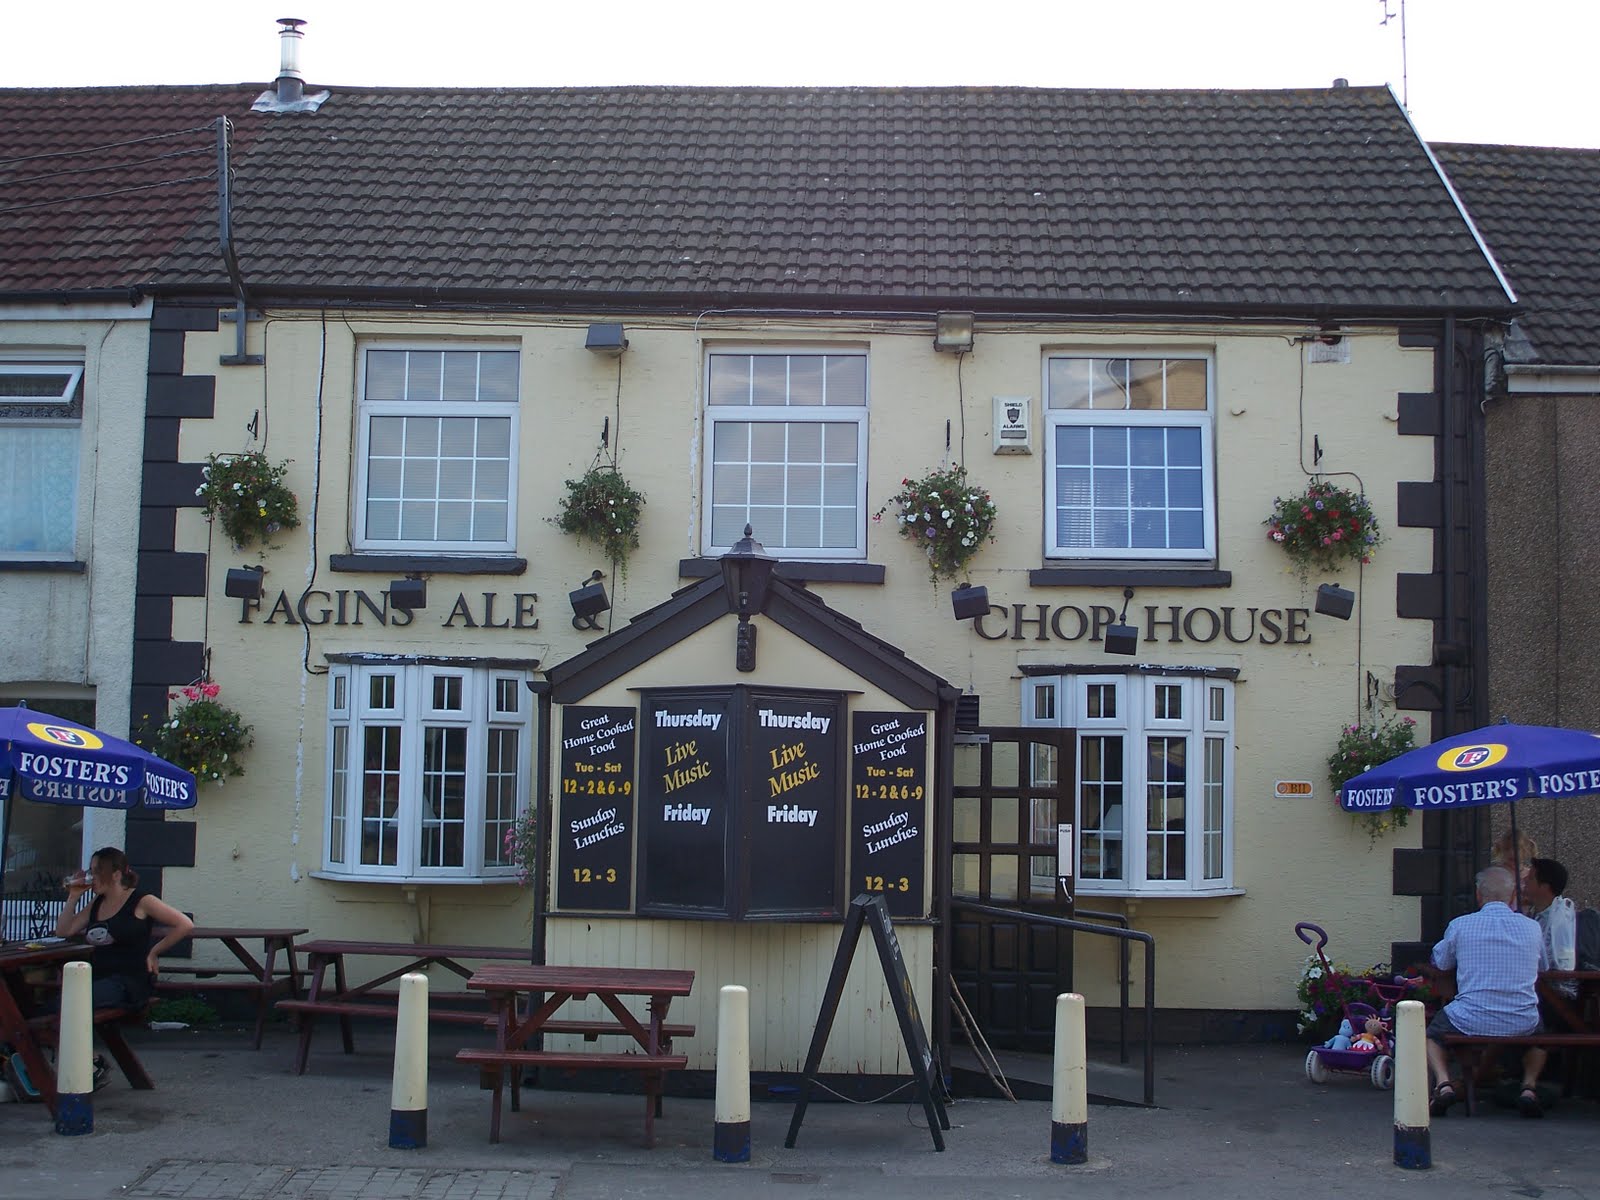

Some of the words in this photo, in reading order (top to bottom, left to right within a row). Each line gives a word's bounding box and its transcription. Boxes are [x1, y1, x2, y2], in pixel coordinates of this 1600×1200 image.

[442, 591, 540, 629] ALE
[973, 603, 1118, 642] CHOP
[1143, 605, 1312, 645] HOUSE
[581, 714, 610, 730] Great
[655, 709, 722, 731] Thursday
[758, 709, 831, 734] Thursday
[871, 719, 900, 735] Great
[563, 733, 596, 749] Home
[596, 718, 635, 739] Cooked
[853, 738, 886, 755] Home
[887, 723, 925, 744] Cooked
[589, 738, 616, 756] Food
[664, 740, 698, 767] Live
[769, 741, 806, 770] Live
[879, 742, 907, 761] Food
[20, 752, 129, 785] FOSTER'S
[575, 762, 594, 773] Tue
[604, 762, 622, 773] Sat
[663, 759, 712, 794] Music
[768, 761, 821, 797] Music
[866, 766, 886, 777] Tue
[896, 767, 914, 777] Sat
[1413, 778, 1518, 806] FOSTER'S
[570, 807, 617, 833] Sunday
[664, 803, 711, 825] Friday
[767, 804, 818, 827] Friday
[862, 811, 909, 837] Sunday
[573, 822, 625, 850] Lunches
[866, 826, 918, 854] Lunches
[573, 868, 591, 882] 12
[606, 868, 616, 883] 3
[865, 876, 884, 891] 12
[899, 877, 909, 892] 3
